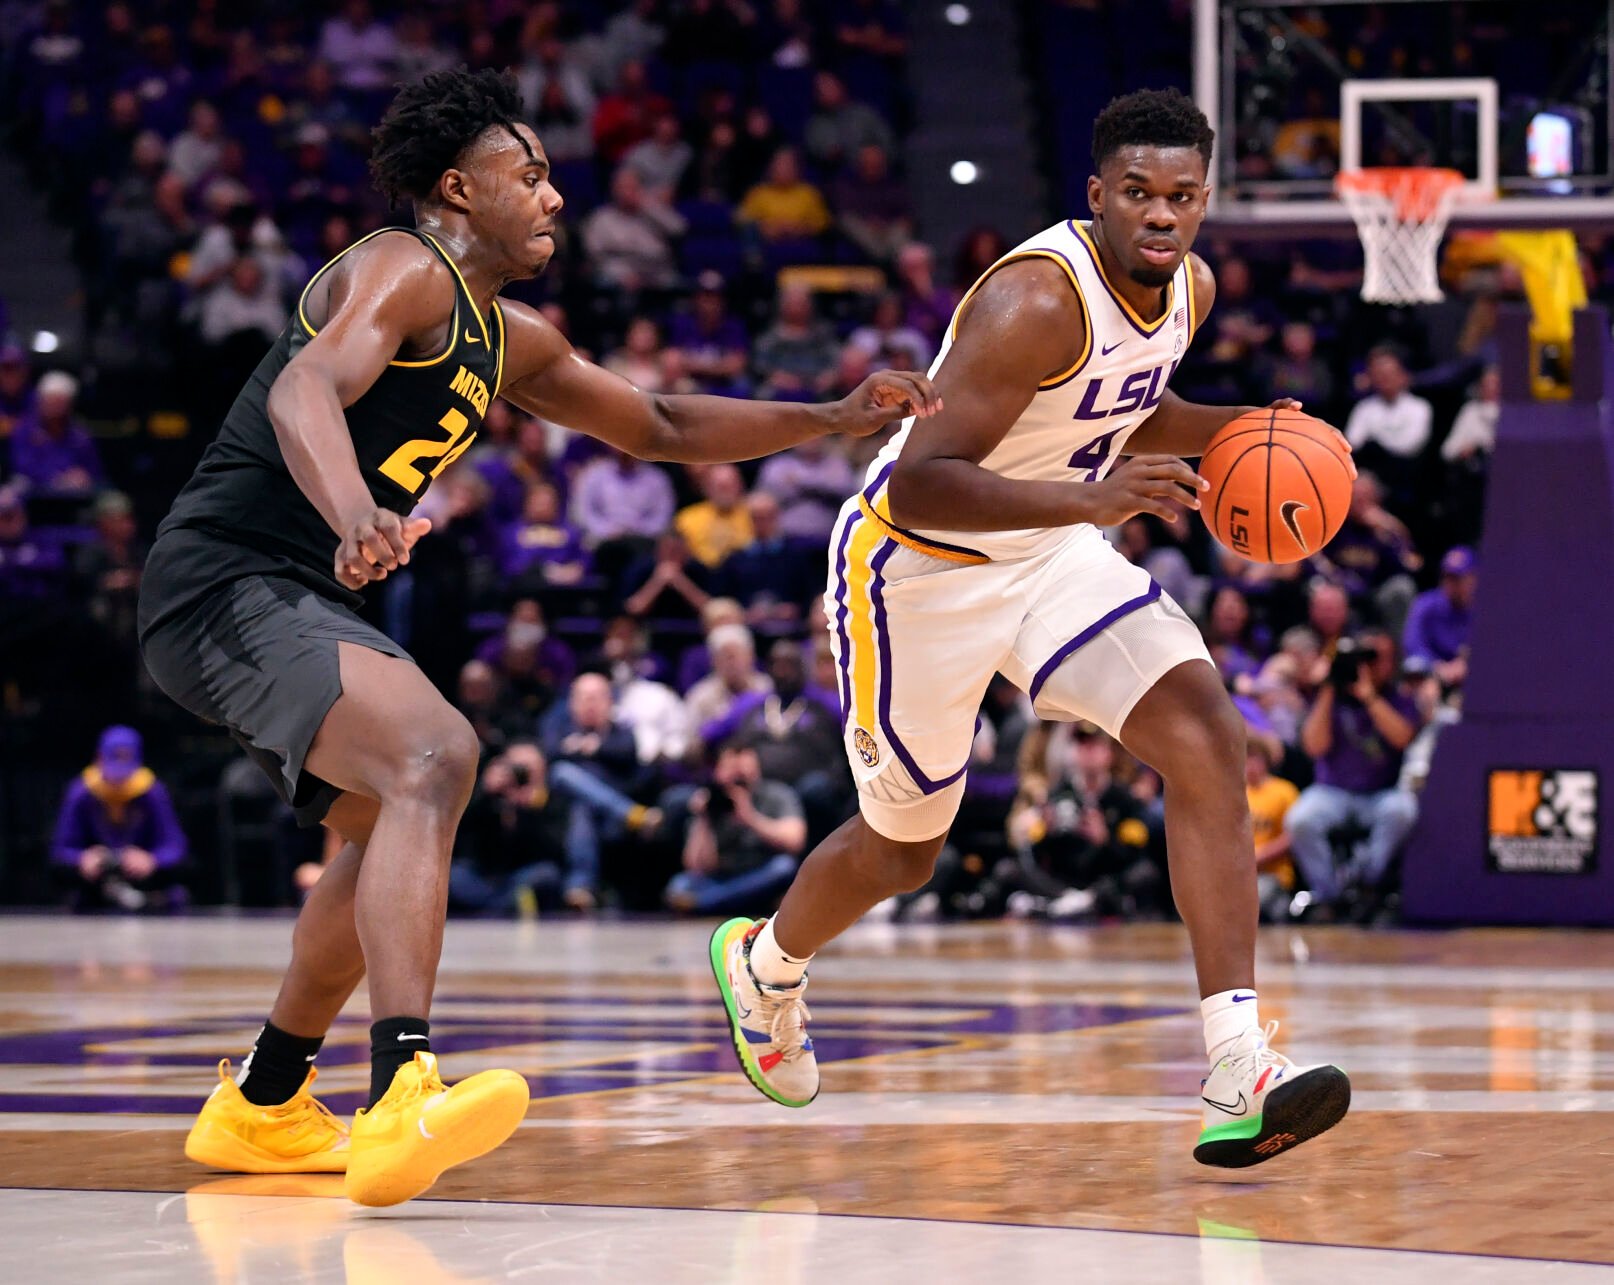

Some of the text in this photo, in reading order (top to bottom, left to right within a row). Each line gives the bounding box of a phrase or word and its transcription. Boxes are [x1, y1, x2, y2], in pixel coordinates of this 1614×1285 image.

[1072, 359, 1180, 420] LSU
[1067, 424, 1131, 482] 4
[1230, 504, 1252, 556] LSU
